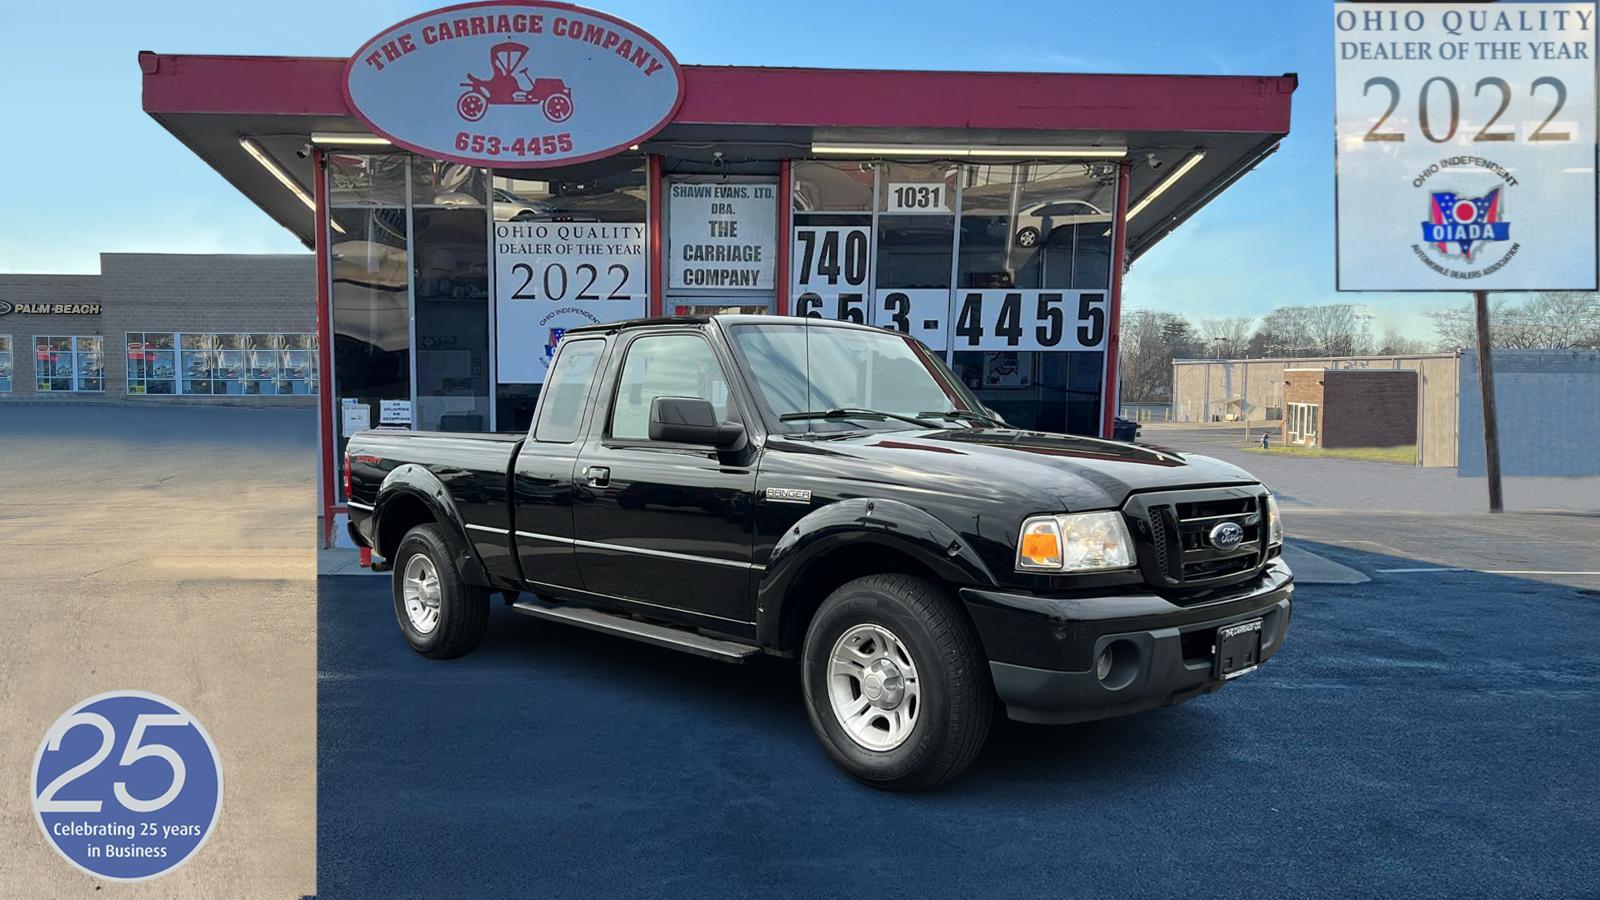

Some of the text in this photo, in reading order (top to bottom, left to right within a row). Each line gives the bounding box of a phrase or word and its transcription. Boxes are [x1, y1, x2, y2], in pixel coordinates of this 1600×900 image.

[1336, 10, 1592, 35] OHIO QUALITY
[366, 14, 664, 77] THE CARRIAGE COMPANY
[1340, 41, 1589, 60] DEALER OF THE YEAR
[1362, 76, 1571, 143] 2022
[455, 132, 573, 157] 653-4455
[1412, 156, 1519, 188] OHIO INDEPENDENT
[672, 186, 712, 199] SHAWN
[754, 186, 775, 199] LTD.
[894, 186, 941, 208] 1031
[711, 203, 736, 215] DBA.
[497, 226, 644, 241] OHIO QUALITY
[708, 220, 738, 238] THE
[1433, 223, 1495, 240] OIADA
[499, 243, 642, 255] DEALER OF THE YEAR
[683, 244, 762, 262] CARRIAGE
[797, 229, 868, 286] 740
[510, 262, 632, 301] 2022
[683, 268, 761, 286] COMPANY
[14, 303, 101, 315] PALM BEACH
[539, 312, 555, 326] OHIO
[767, 488, 811, 500] RANGER
